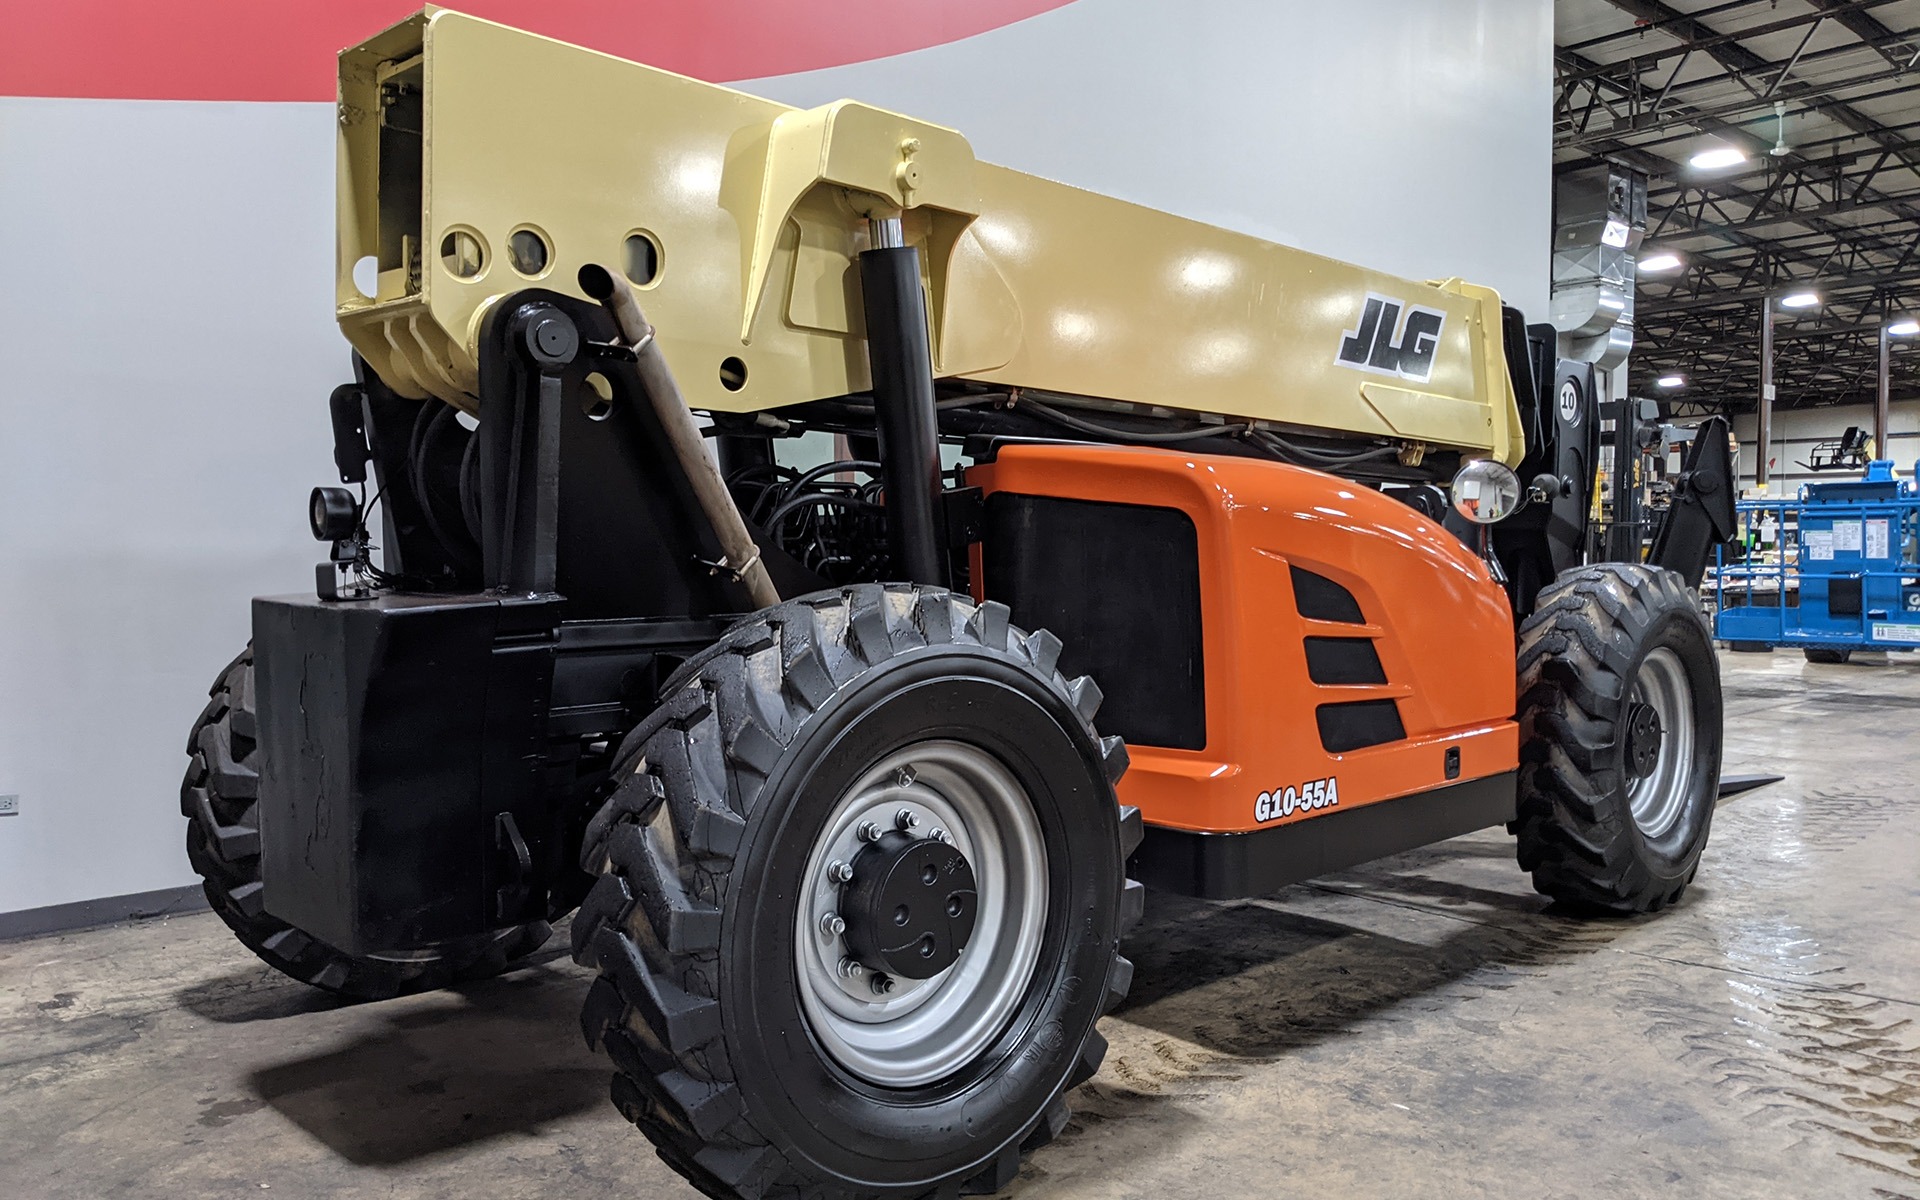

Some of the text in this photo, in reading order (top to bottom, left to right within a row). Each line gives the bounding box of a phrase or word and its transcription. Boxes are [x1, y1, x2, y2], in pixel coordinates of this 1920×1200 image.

[1338, 296, 1443, 378] JLG
[1561, 391, 1575, 410] 10
[1254, 776, 1338, 823] G10-55A
